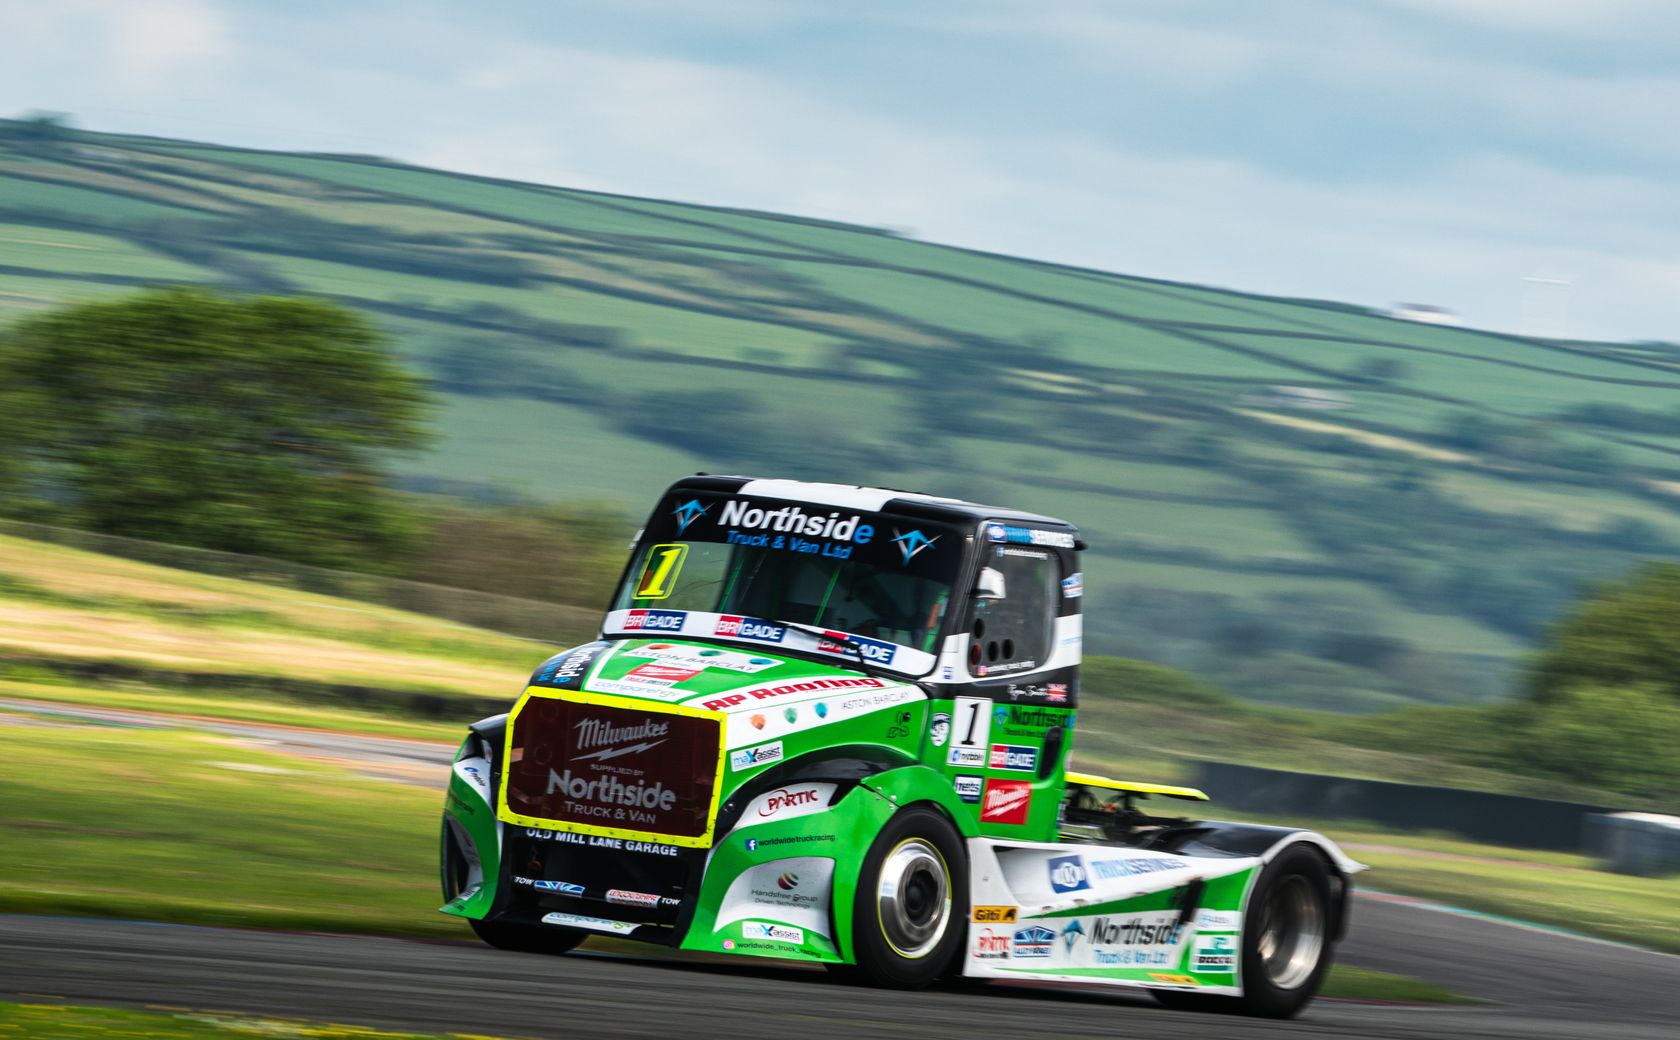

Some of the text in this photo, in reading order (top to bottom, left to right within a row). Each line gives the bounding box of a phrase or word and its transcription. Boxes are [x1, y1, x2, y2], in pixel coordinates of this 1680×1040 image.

[718, 500, 875, 544] Northside
[725, 530, 854, 560] Truck & Van Ltd
[639, 547, 684, 597] 1
[623, 613, 682, 630] BRIGADE
[715, 619, 782, 640] BRIGADE
[748, 677, 886, 700] Roofing
[573, 717, 670, 750] Milwaukee
[960, 702, 981, 745] 1
[590, 763, 631, 775] SUPPLIED
[547, 767, 677, 811] Northside
[767, 789, 818, 811] PARTIC
[564, 800, 657, 824] TRUCK & VAN
[526, 827, 678, 857] OLD MILL LANE GARAGE
[513, 876, 535, 886] TOW
[661, 896, 681, 906] TOW
